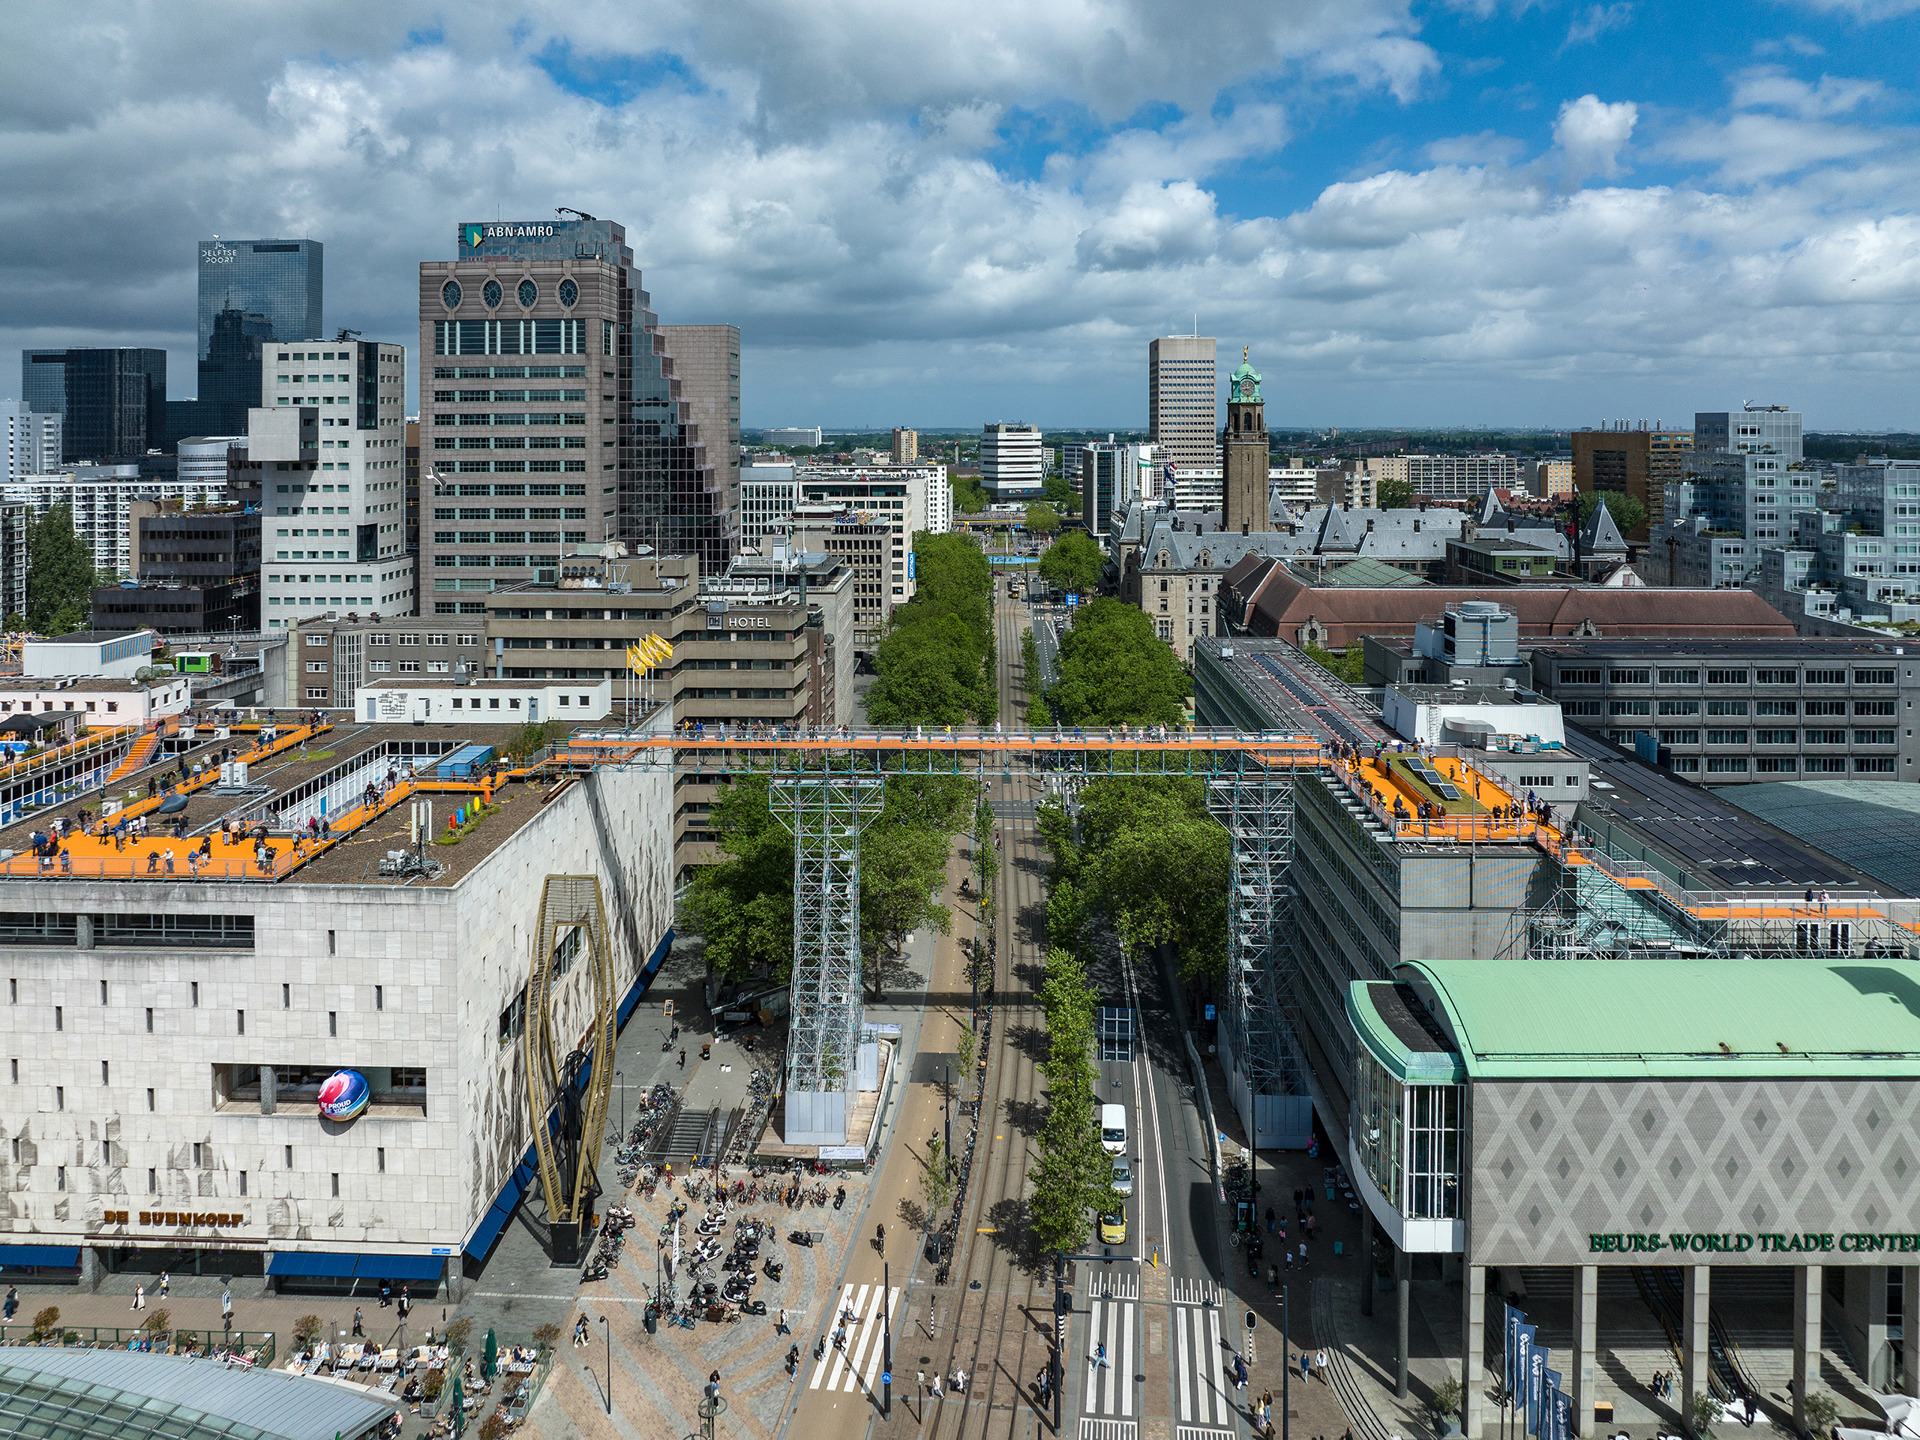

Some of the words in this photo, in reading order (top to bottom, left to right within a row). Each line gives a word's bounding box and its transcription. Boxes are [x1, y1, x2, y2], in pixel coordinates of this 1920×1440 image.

[202, 249, 237, 257] DELFTSE
[728, 617, 772, 628] HOTEL
[328, 1099, 352, 1109] PROUD
[104, 1210, 128, 1224] DE
[1757, 1233, 1835, 1252] TRADE
